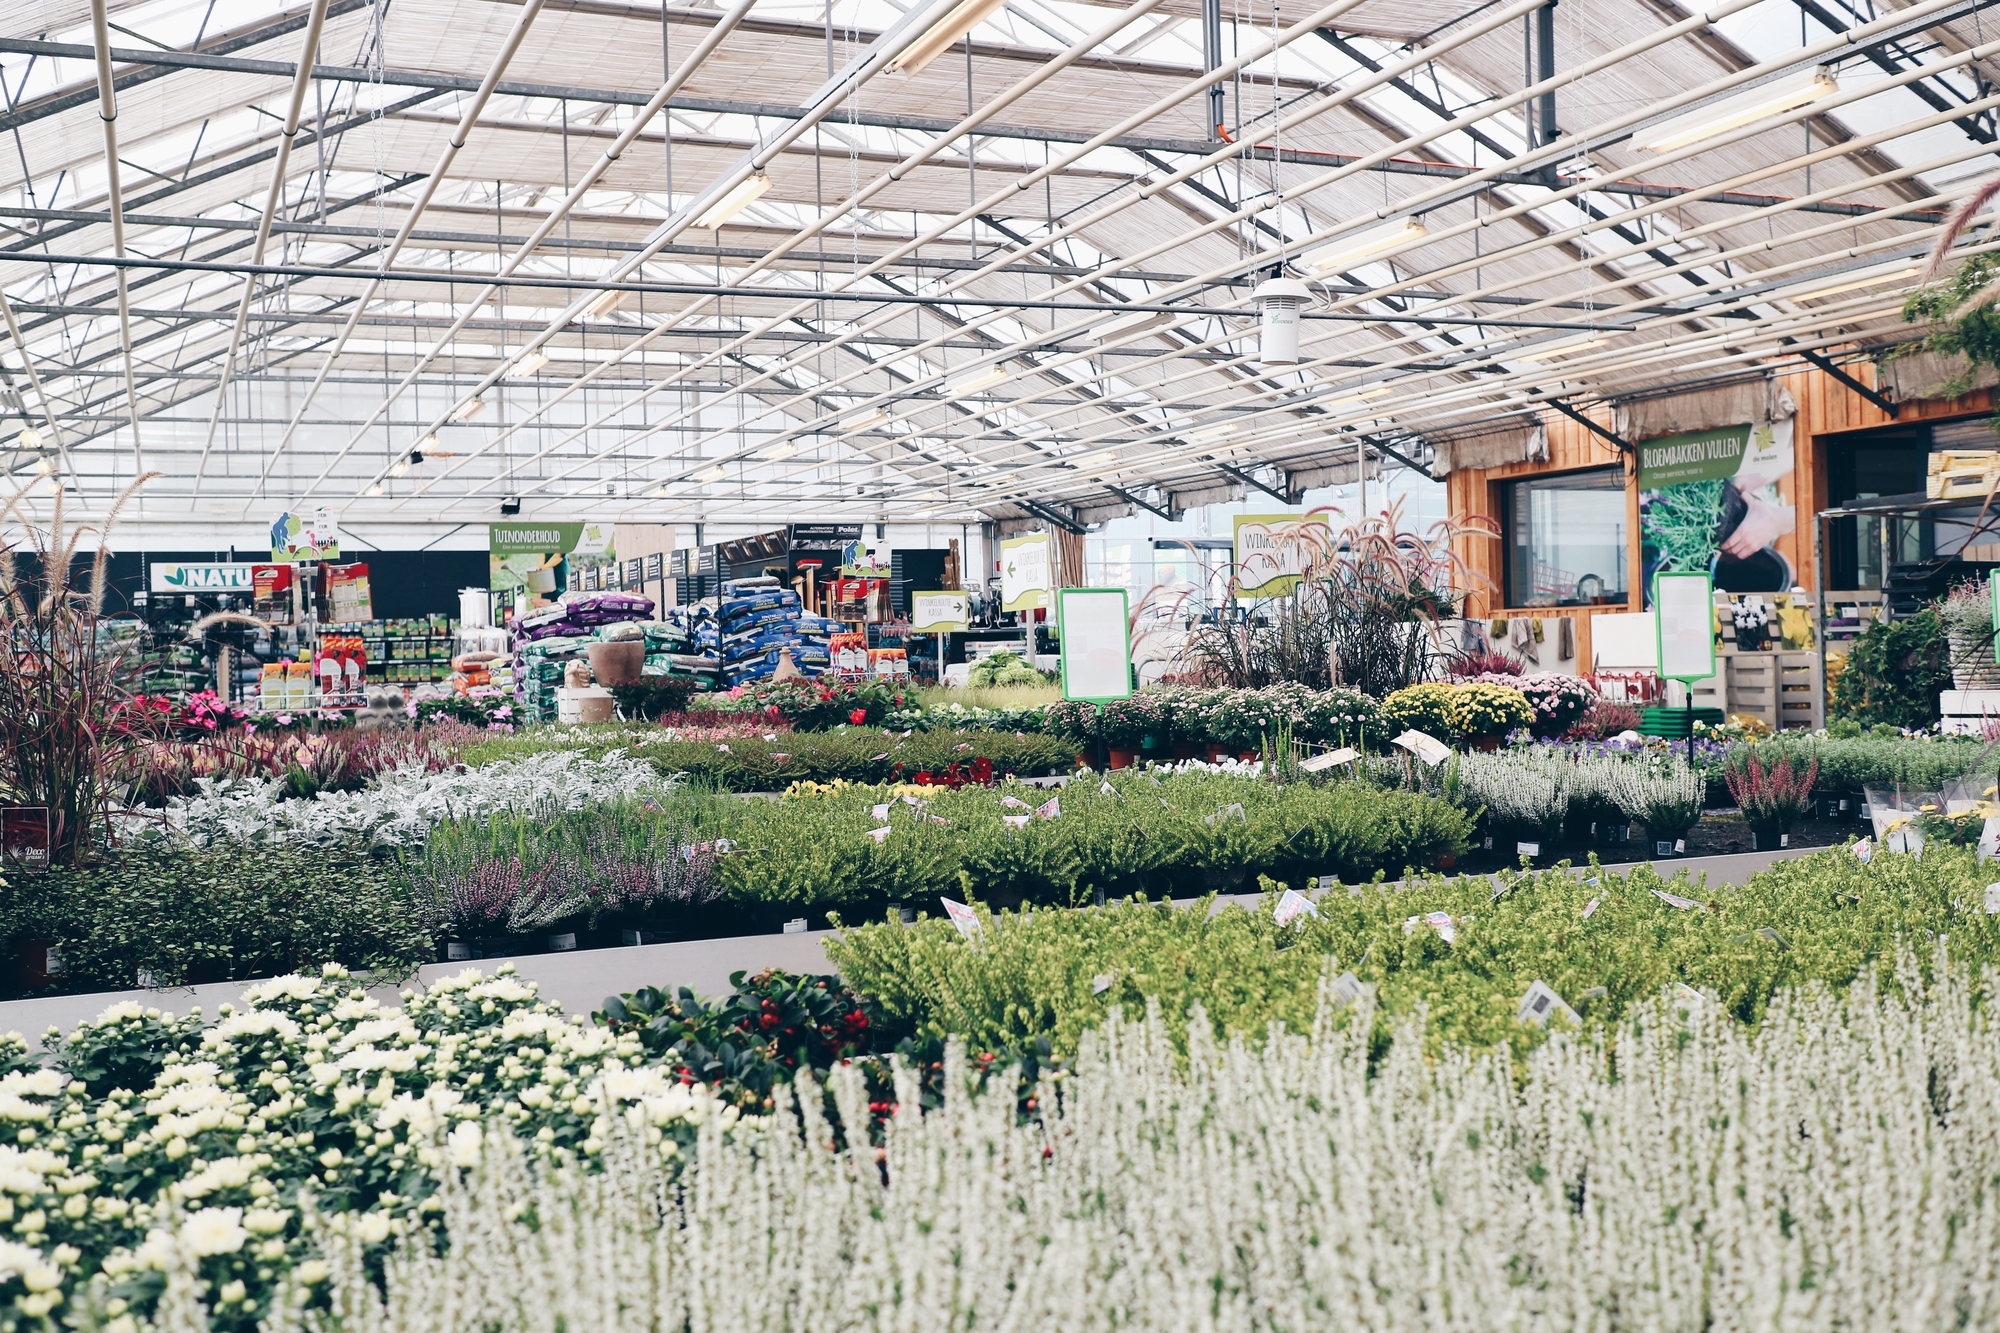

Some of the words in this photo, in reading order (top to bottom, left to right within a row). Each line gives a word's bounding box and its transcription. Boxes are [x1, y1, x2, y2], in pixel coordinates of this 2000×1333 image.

[1643, 442, 1705, 469] BLOEMBAKKEN
[1706, 437, 1740, 459] VULLEN
[494, 529, 560, 543] TUINONDERHOUD
